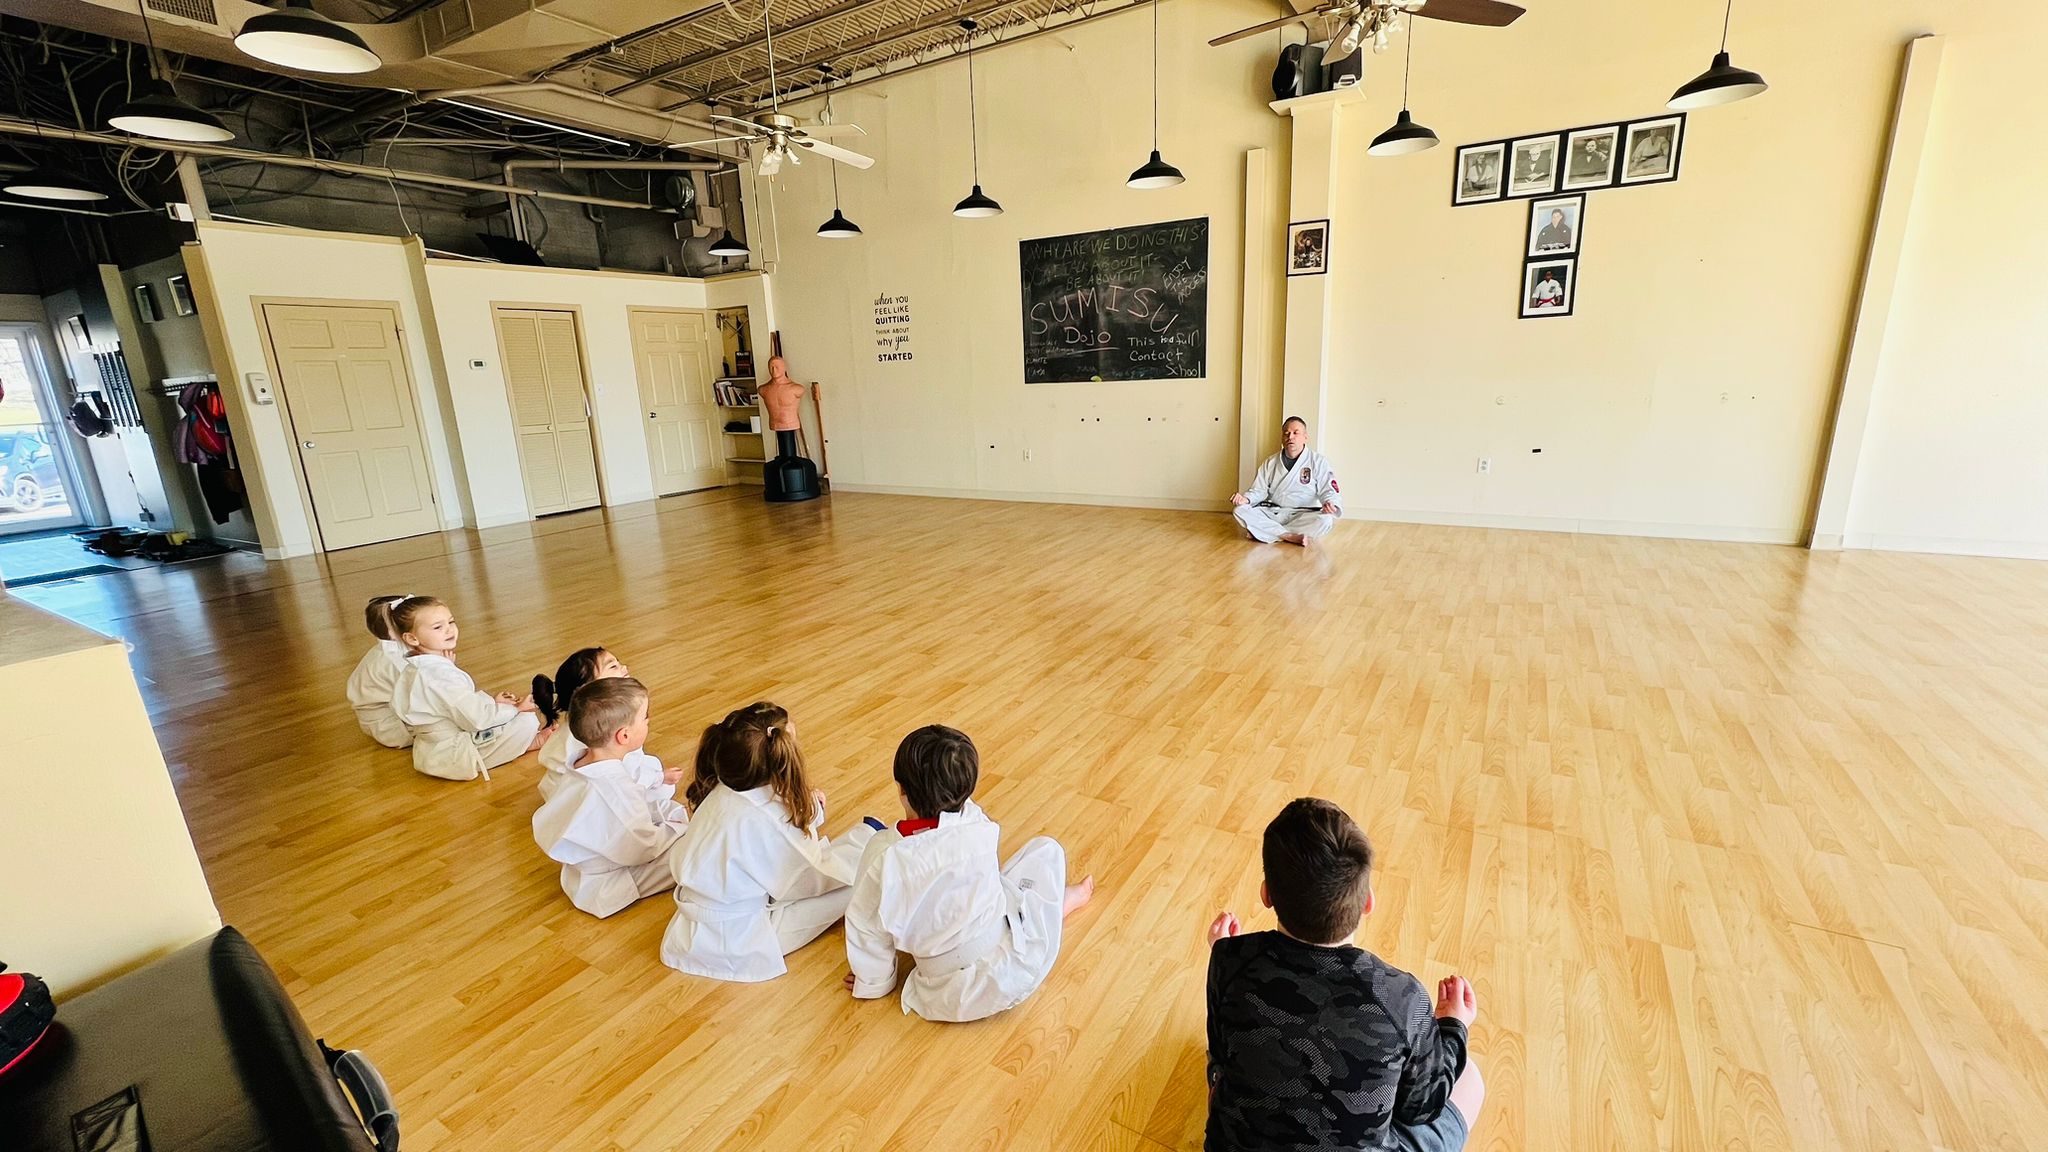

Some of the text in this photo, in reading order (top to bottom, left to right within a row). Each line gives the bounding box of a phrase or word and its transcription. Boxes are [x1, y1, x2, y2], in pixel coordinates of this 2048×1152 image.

[1030, 222, 1207, 261] WHY ARE WE DOING THIS?
[1091, 257, 1135, 273] ABOUT
[1161, 256, 1191, 290] ENJOY
[1066, 277, 1081, 291] BE
[1088, 272, 1123, 286] ABOUT
[895, 296, 909, 304] YOU
[874, 305, 909, 315] FEEL LIKE
[1029, 284, 1179, 334] SUMISU
[875, 315, 910, 325] QUITTING
[876, 335, 909, 351] why you
[1127, 336, 1156, 347] This
[878, 352, 913, 362] STARTED
[1129, 347, 1184, 362] Contact
